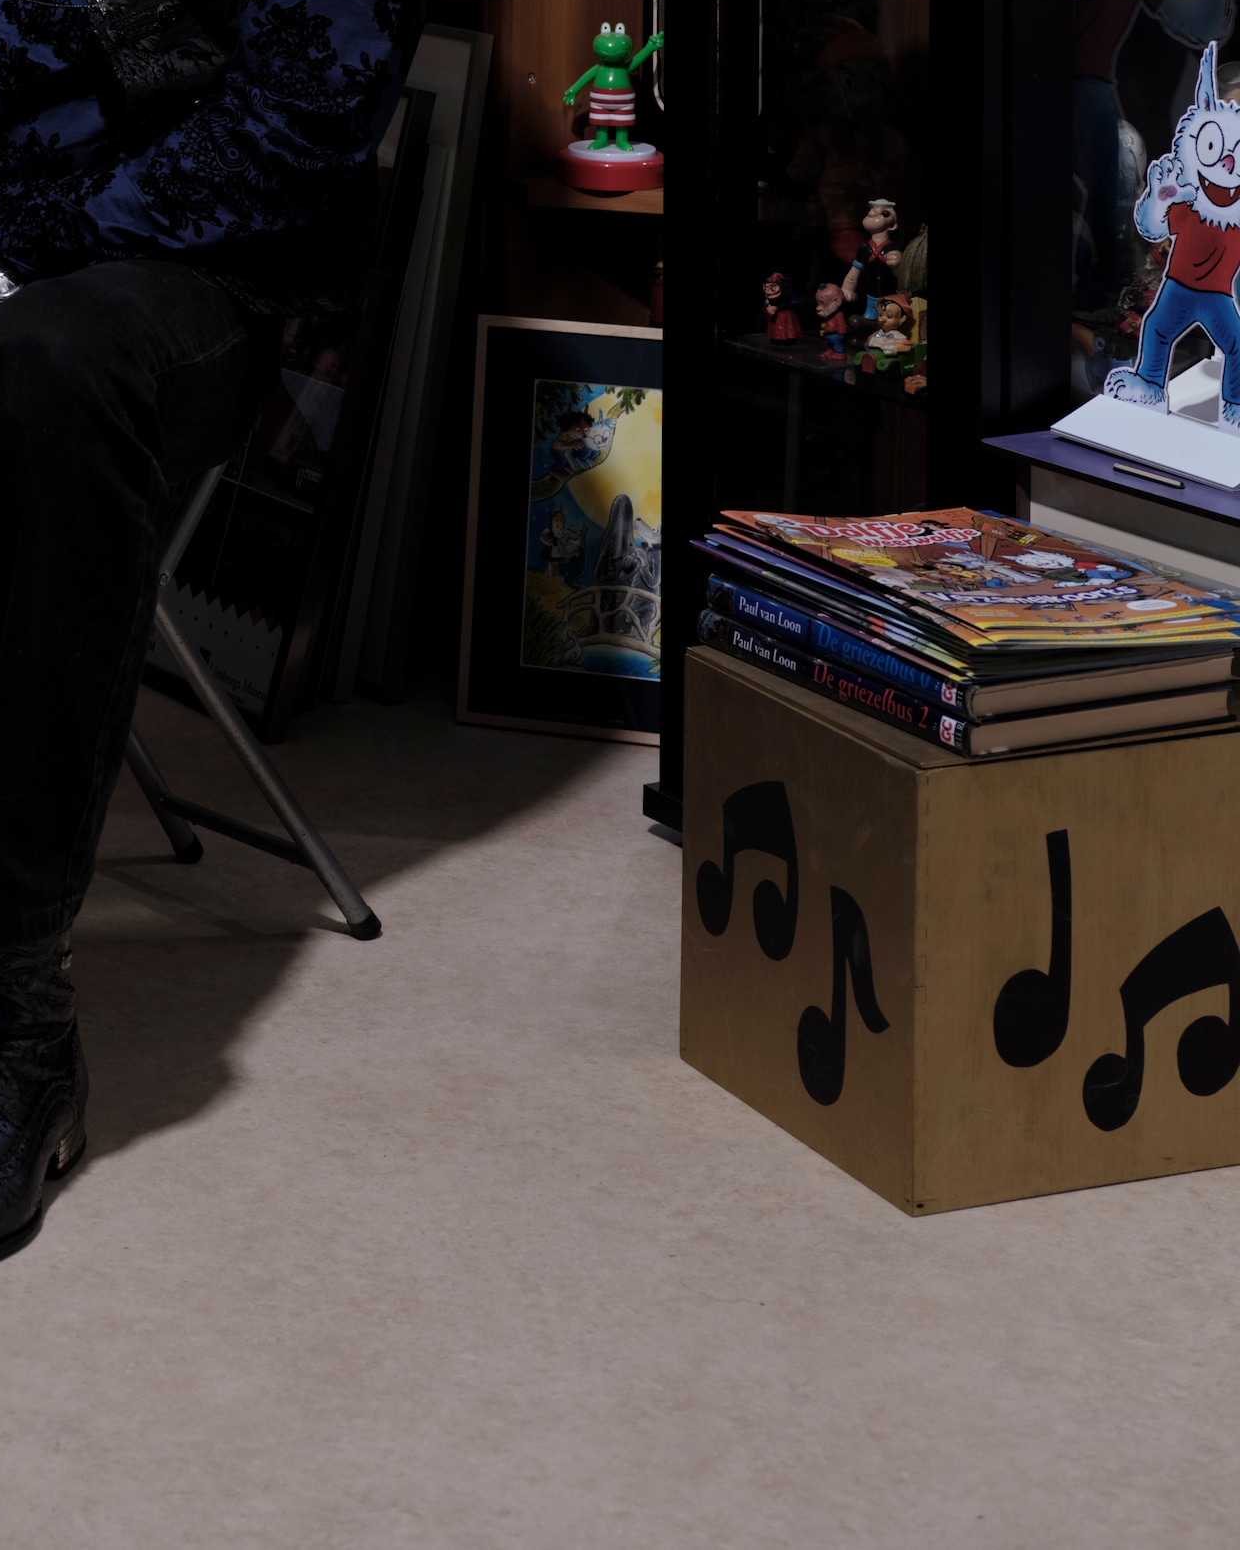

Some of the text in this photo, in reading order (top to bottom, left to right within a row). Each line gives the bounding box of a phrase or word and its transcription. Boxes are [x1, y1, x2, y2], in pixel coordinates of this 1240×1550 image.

[809, 520, 925, 540] Dolfje
[738, 595, 761, 617] Paul
[760, 608, 777, 625] van
[777, 613, 802, 635] Loon
[817, 622, 839, 651] De
[842, 640, 917, 684] griezelbus
[732, 630, 754, 652] Paul
[754, 644, 771, 660] van
[773, 651, 797, 672] Loon
[813, 661, 835, 690] De
[838, 676, 913, 724] griezelbus
[917, 705, 930, 729] 2
[940, 717, 955, 744] GC
